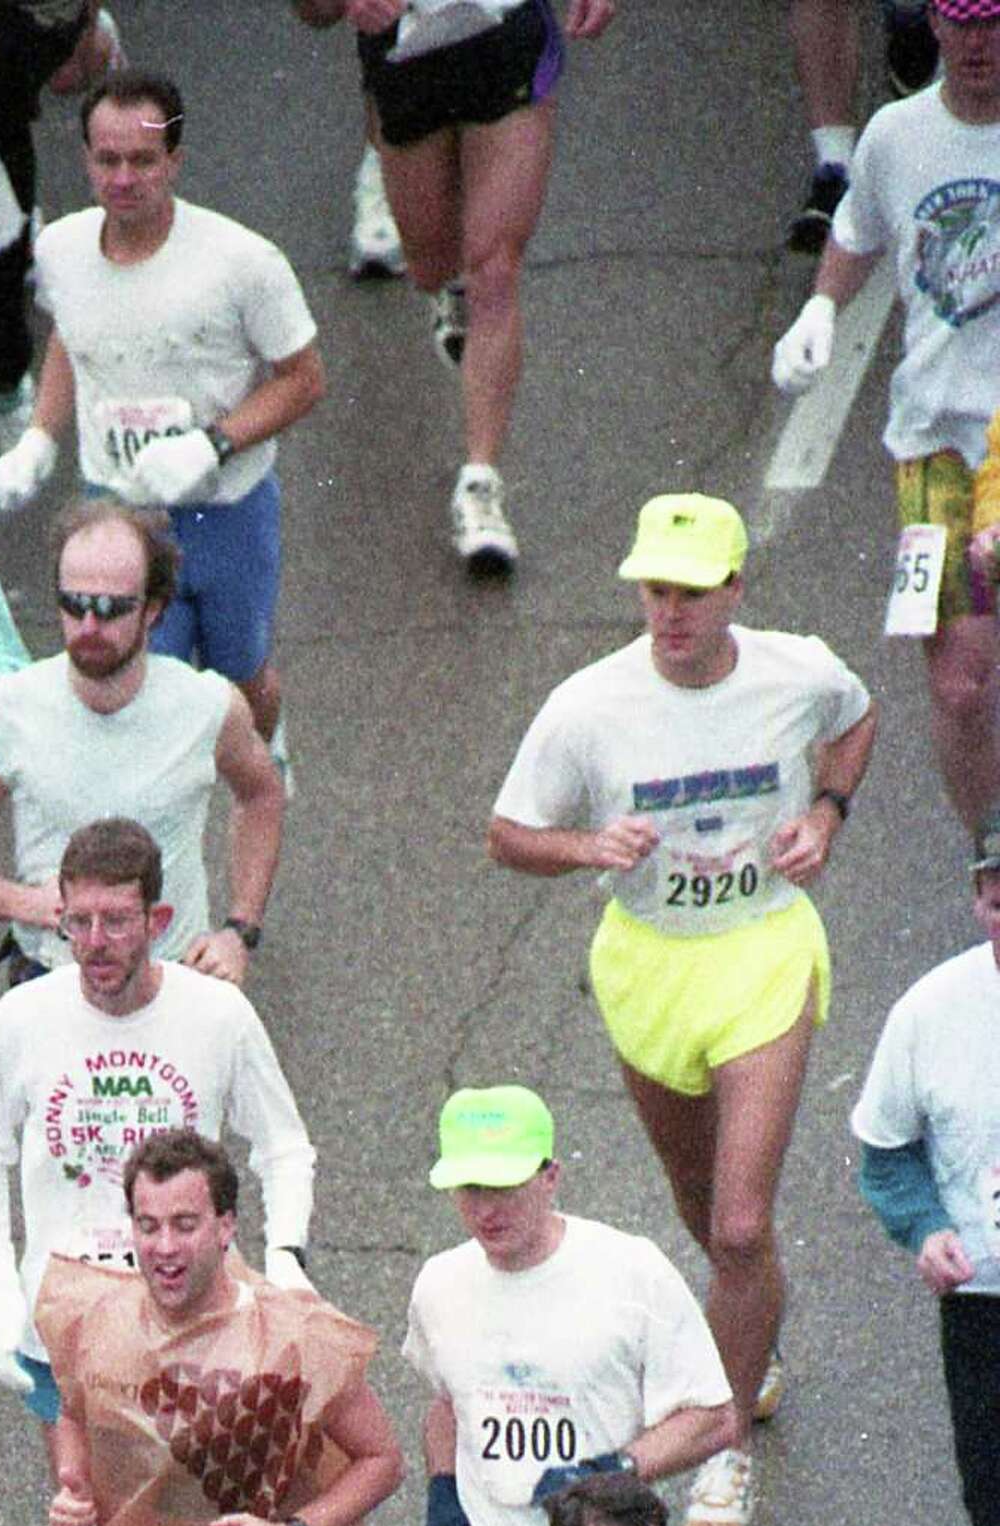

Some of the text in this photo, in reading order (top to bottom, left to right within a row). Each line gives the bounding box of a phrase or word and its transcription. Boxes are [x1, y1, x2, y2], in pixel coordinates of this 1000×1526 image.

[666, 862, 758, 908] 2920
[92, 1076, 154, 1097] MAA
[46, 1073, 74, 1157] SONNY
[137, 1106, 169, 1123] Bell
[71, 1125, 104, 1146] 5K
[481, 1416, 577, 1462] 2000
